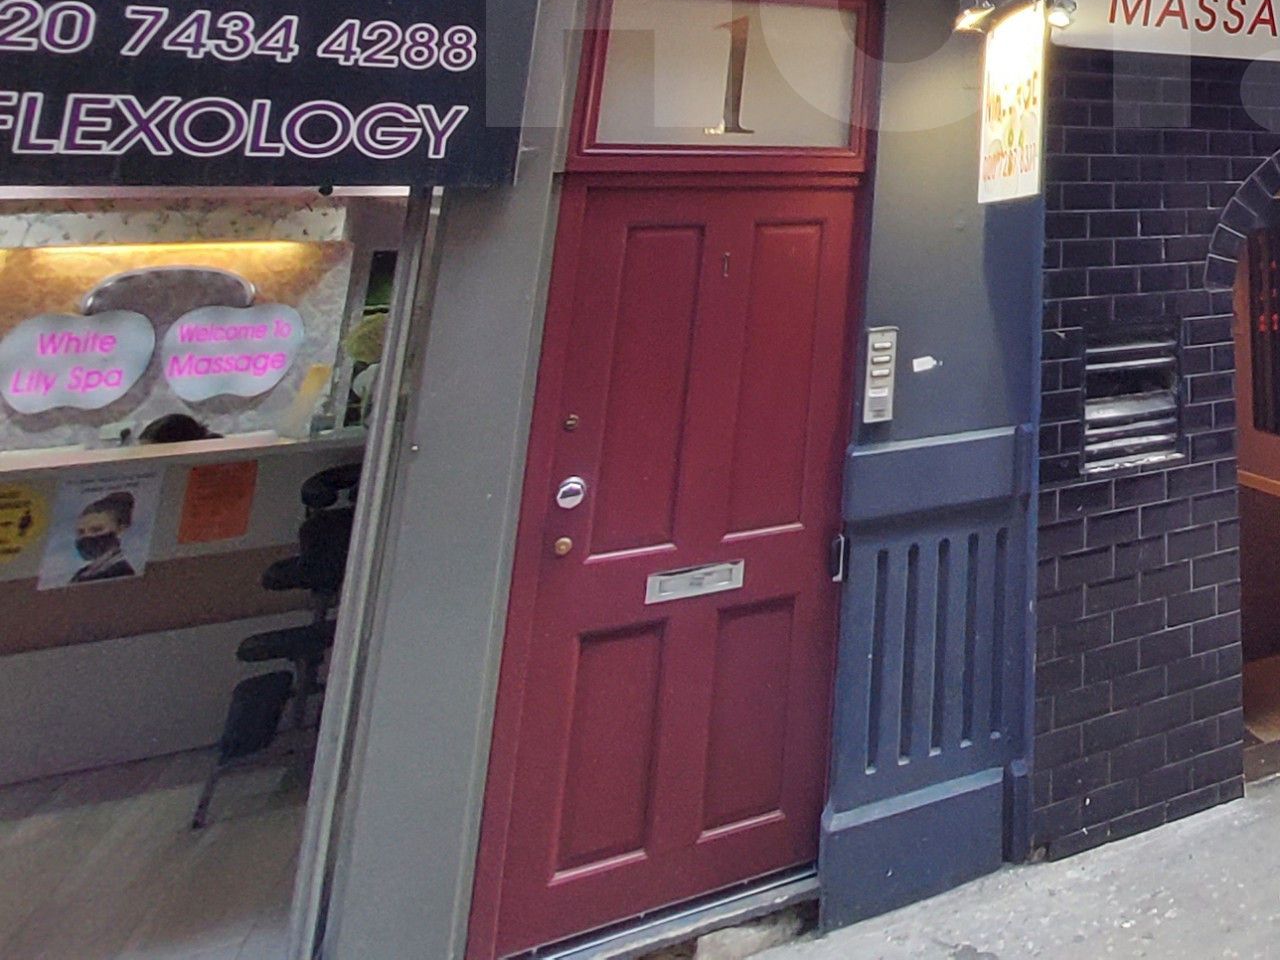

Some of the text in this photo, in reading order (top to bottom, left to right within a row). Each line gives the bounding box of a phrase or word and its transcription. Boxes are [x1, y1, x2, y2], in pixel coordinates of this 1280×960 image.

[121, 6, 300, 64] 7434
[318, 19, 478, 72] 4288
[704, 15, 755, 135] 1
[36, 331, 118, 357] White
[178, 319, 292, 344] Welcome To
[167, 352, 289, 377] Massage
[10, 366, 124, 395] Lily Spa
